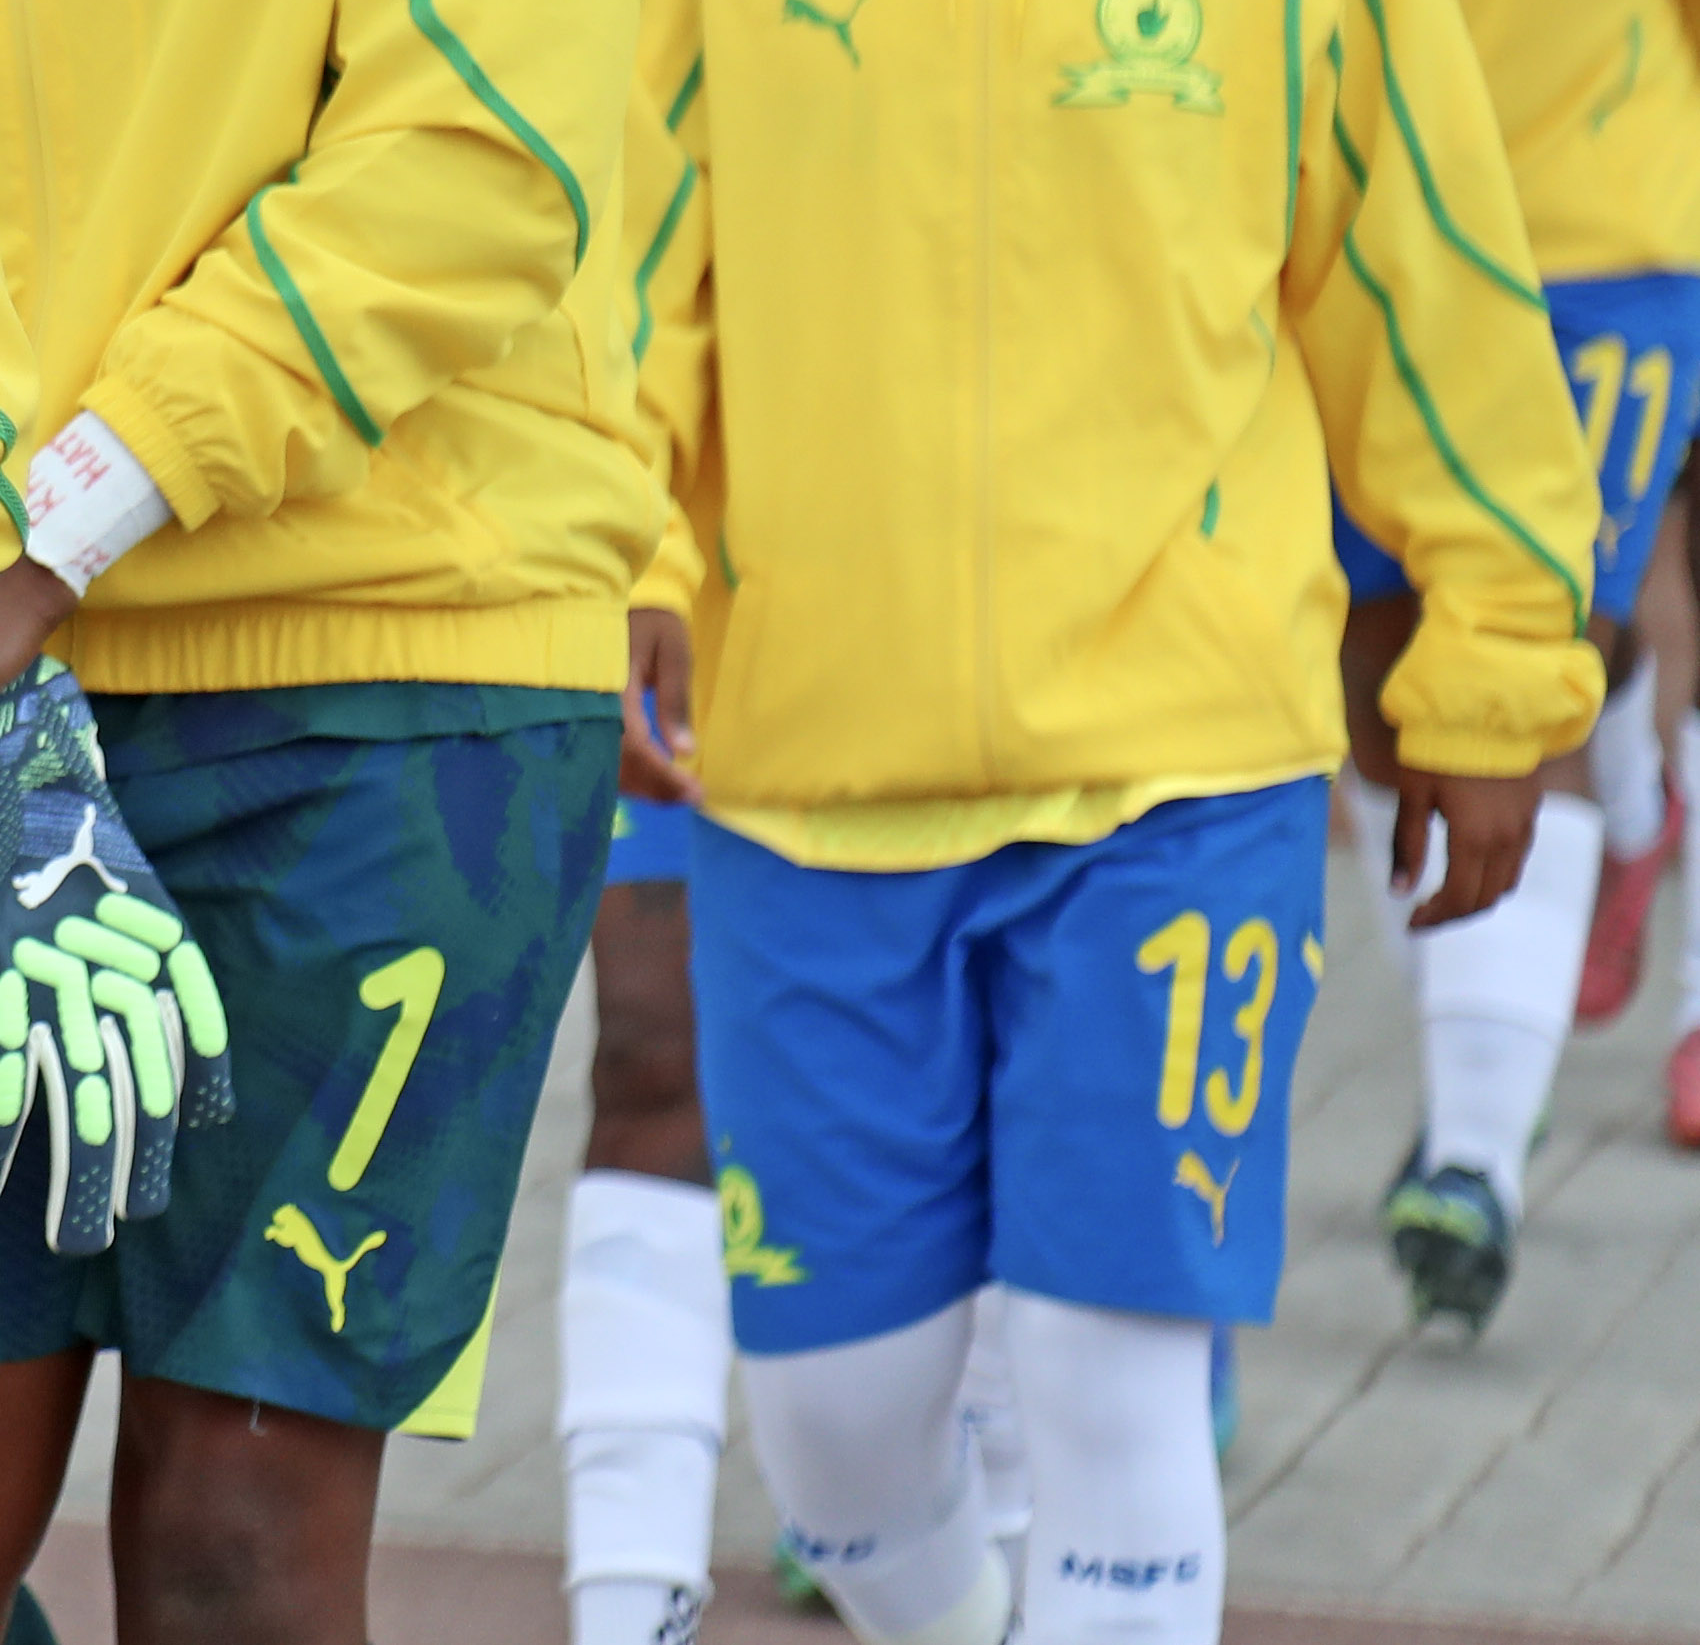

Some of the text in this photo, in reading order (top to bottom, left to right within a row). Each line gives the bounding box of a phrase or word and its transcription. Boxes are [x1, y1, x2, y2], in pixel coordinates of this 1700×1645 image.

[1572, 331, 1673, 502] 11
[327, 945, 447, 1192] 1
[1135, 908, 1279, 1137] 13
